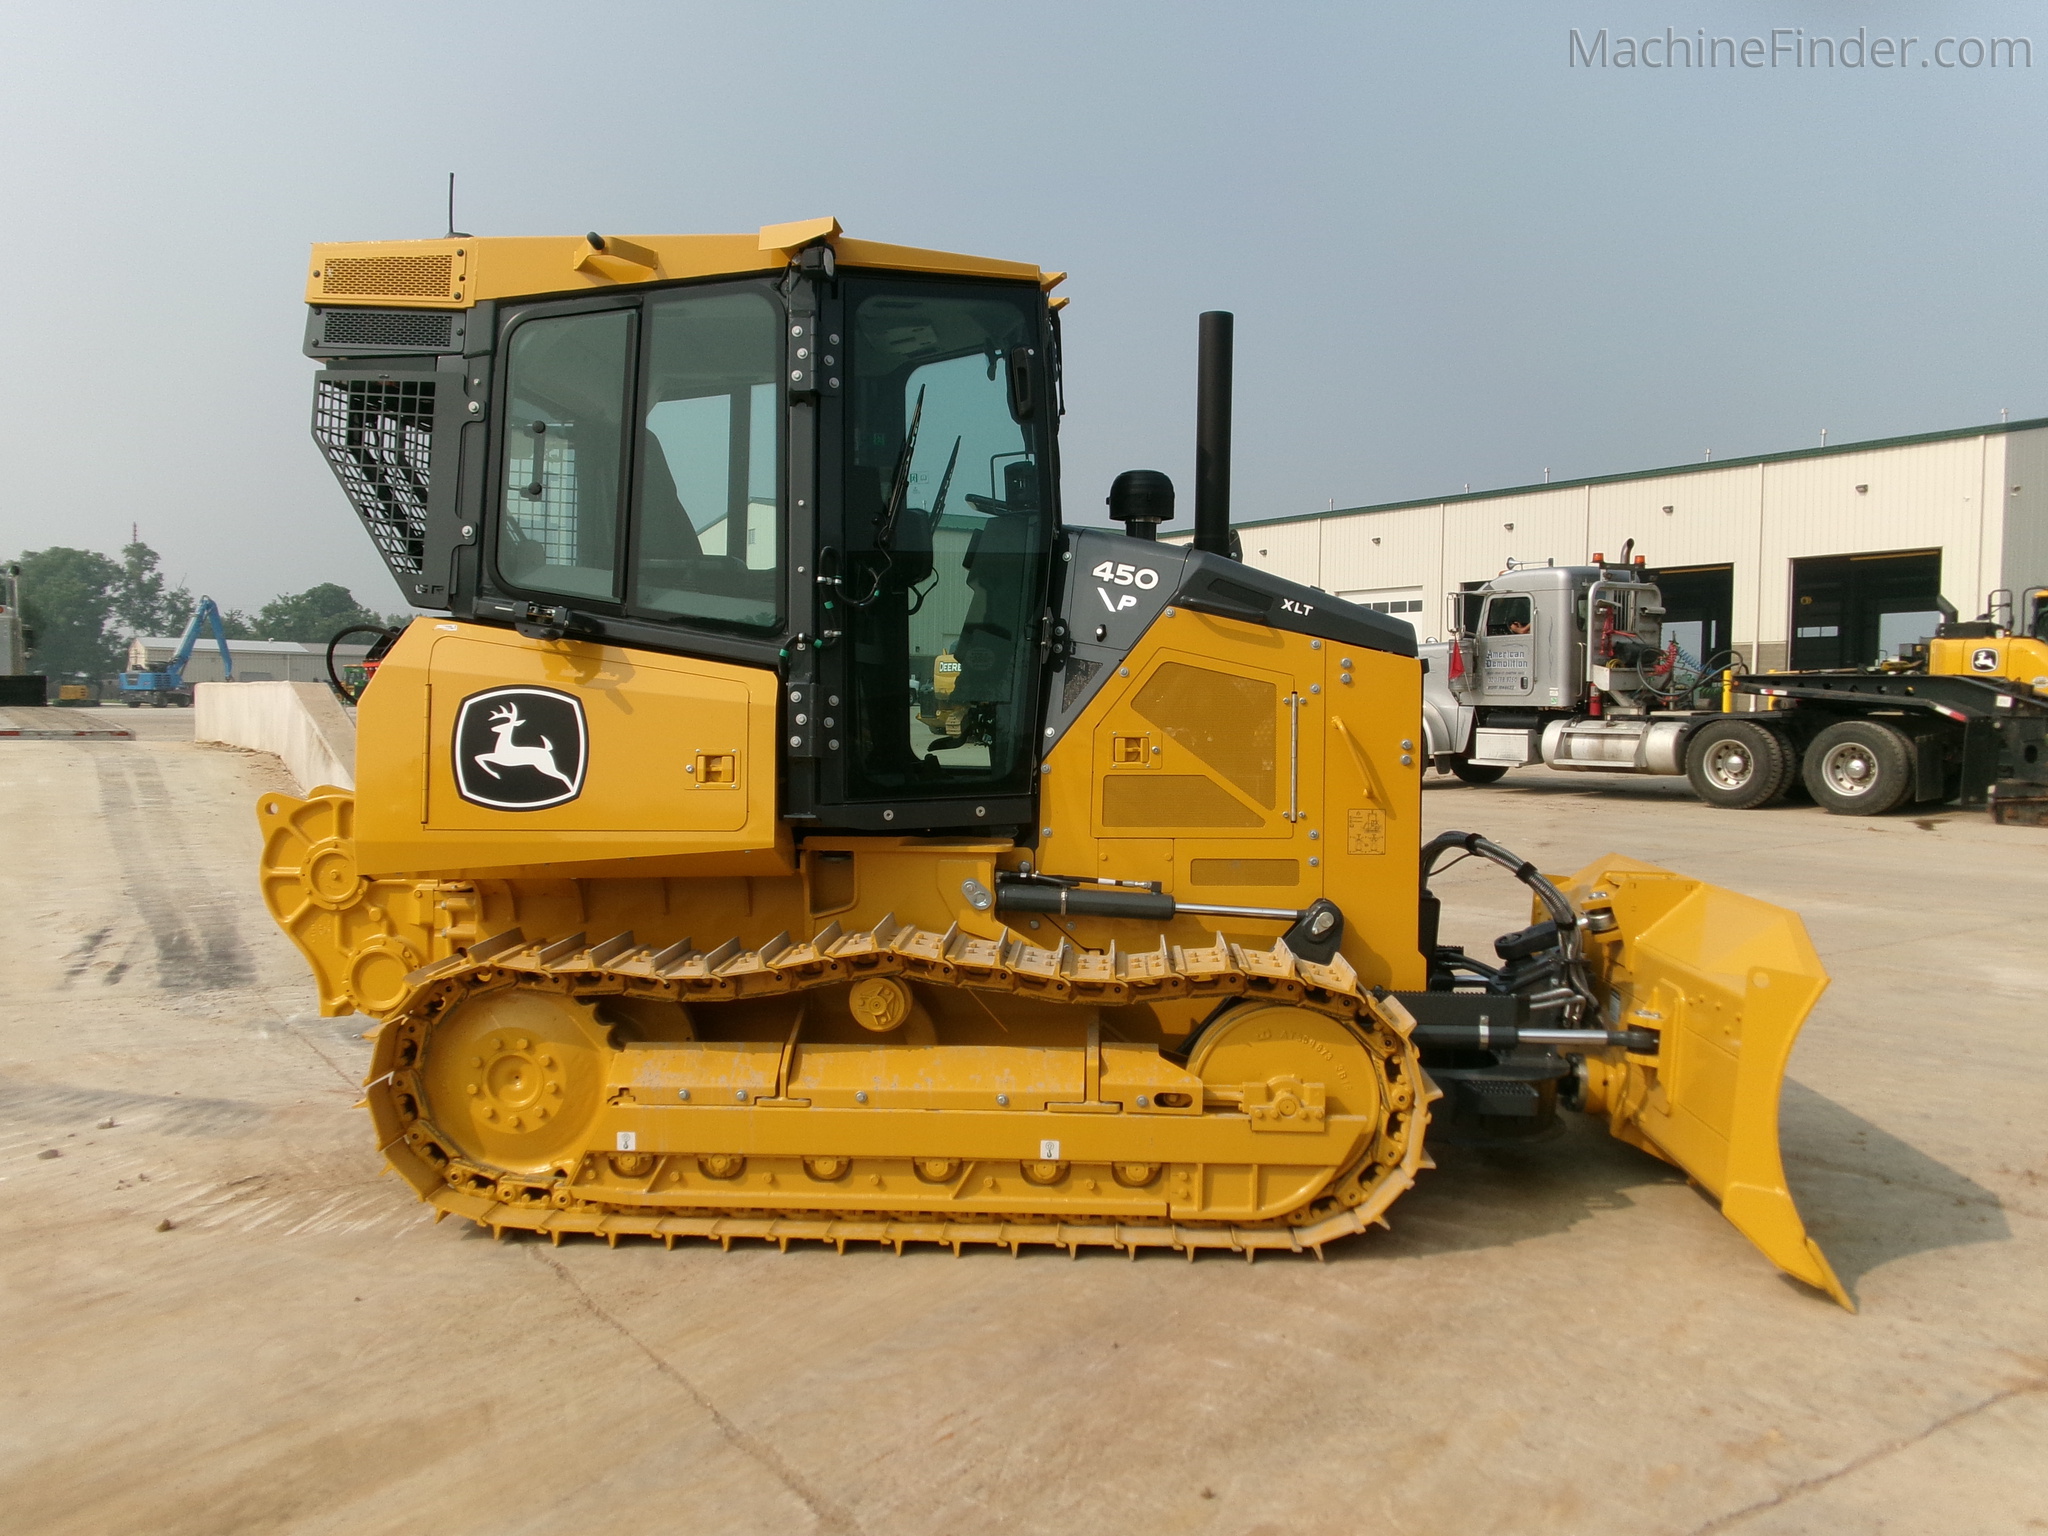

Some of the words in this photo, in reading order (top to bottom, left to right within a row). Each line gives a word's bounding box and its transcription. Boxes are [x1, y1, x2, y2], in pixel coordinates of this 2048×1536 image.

[1092, 560, 1159, 590] 450
[1281, 598, 1314, 616] XLT
[1486, 649, 1525, 659] American
[939, 661, 962, 672] DEERE
[1486, 659, 1528, 669] Demolition
